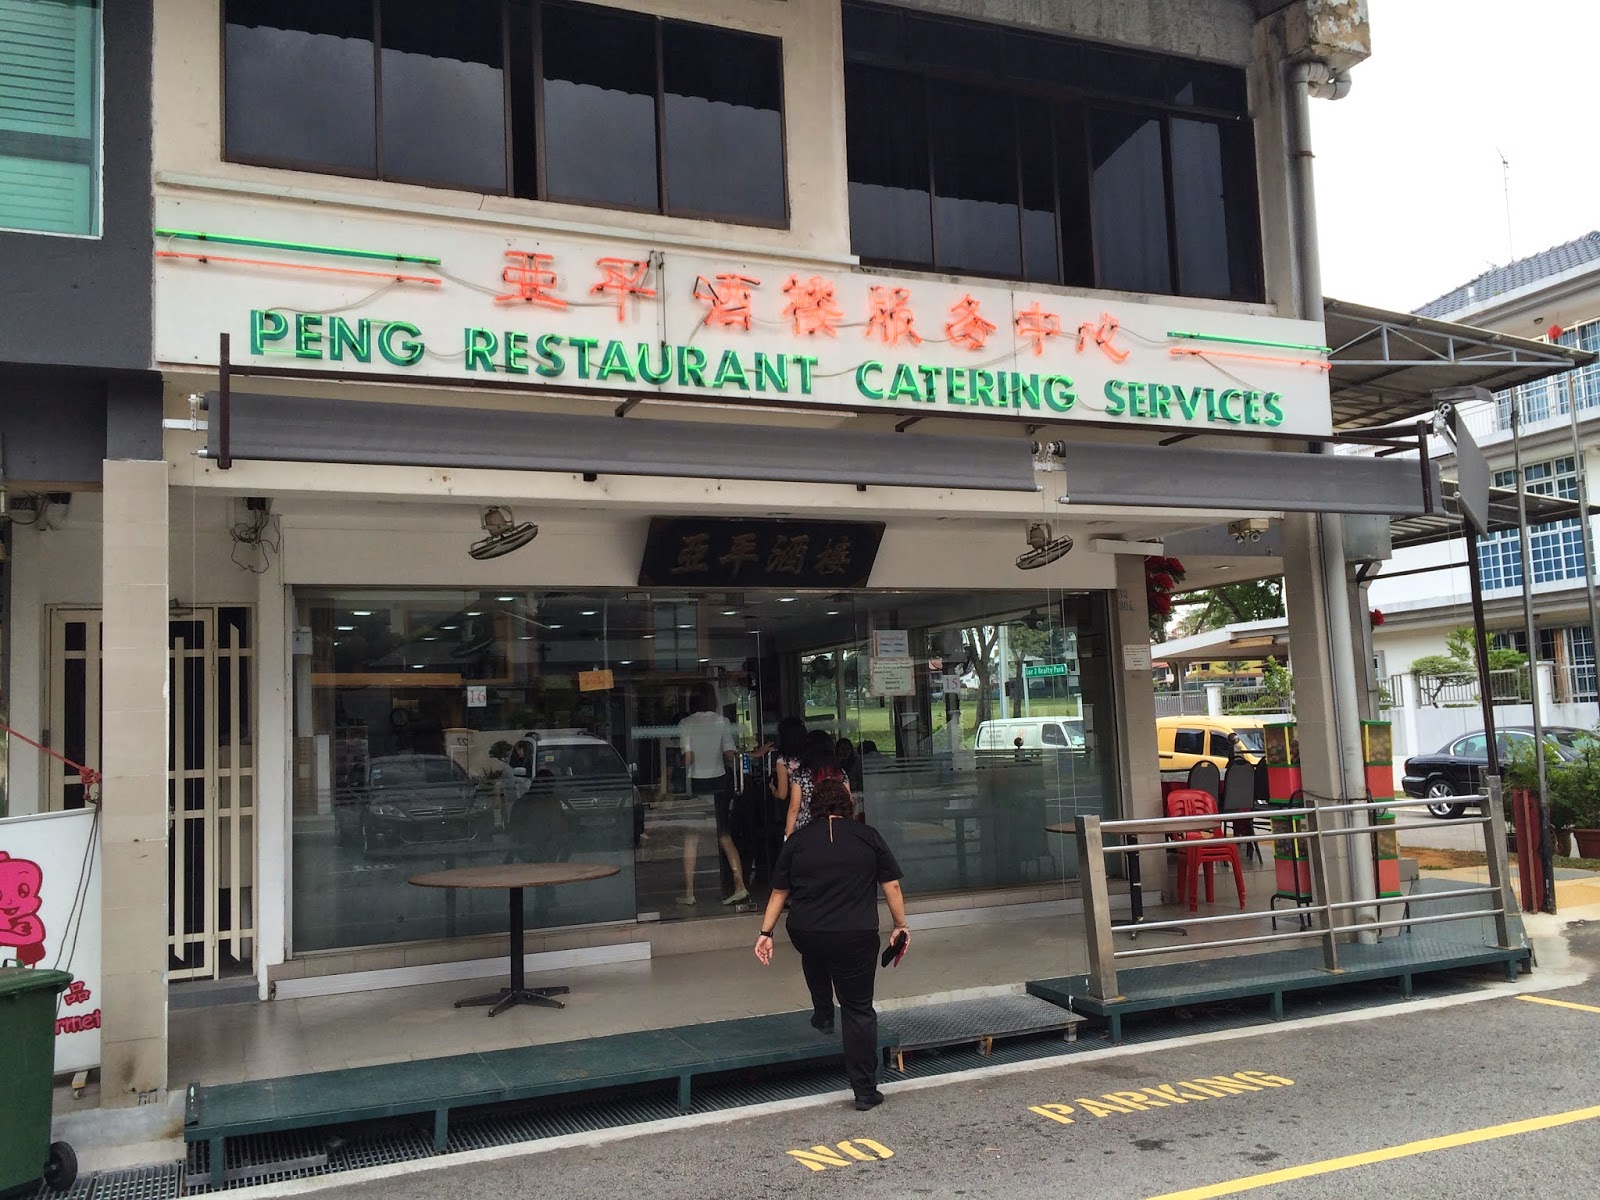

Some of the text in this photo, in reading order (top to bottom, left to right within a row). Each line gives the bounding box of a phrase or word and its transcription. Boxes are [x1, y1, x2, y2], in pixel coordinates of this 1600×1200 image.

[250, 309, 1285, 427] PENG RESTAURANT CATERING SERVICES
[1038, 665, 1053, 675] Realty
[1053, 664, 1064, 674] Park
[470, 689, 486, 703] 16
[945, 677, 958, 690] 15
[64, 980, 92, 1006] 品
[1027, 1069, 1295, 1125] PARKING
[786, 1138, 895, 1172] NO
